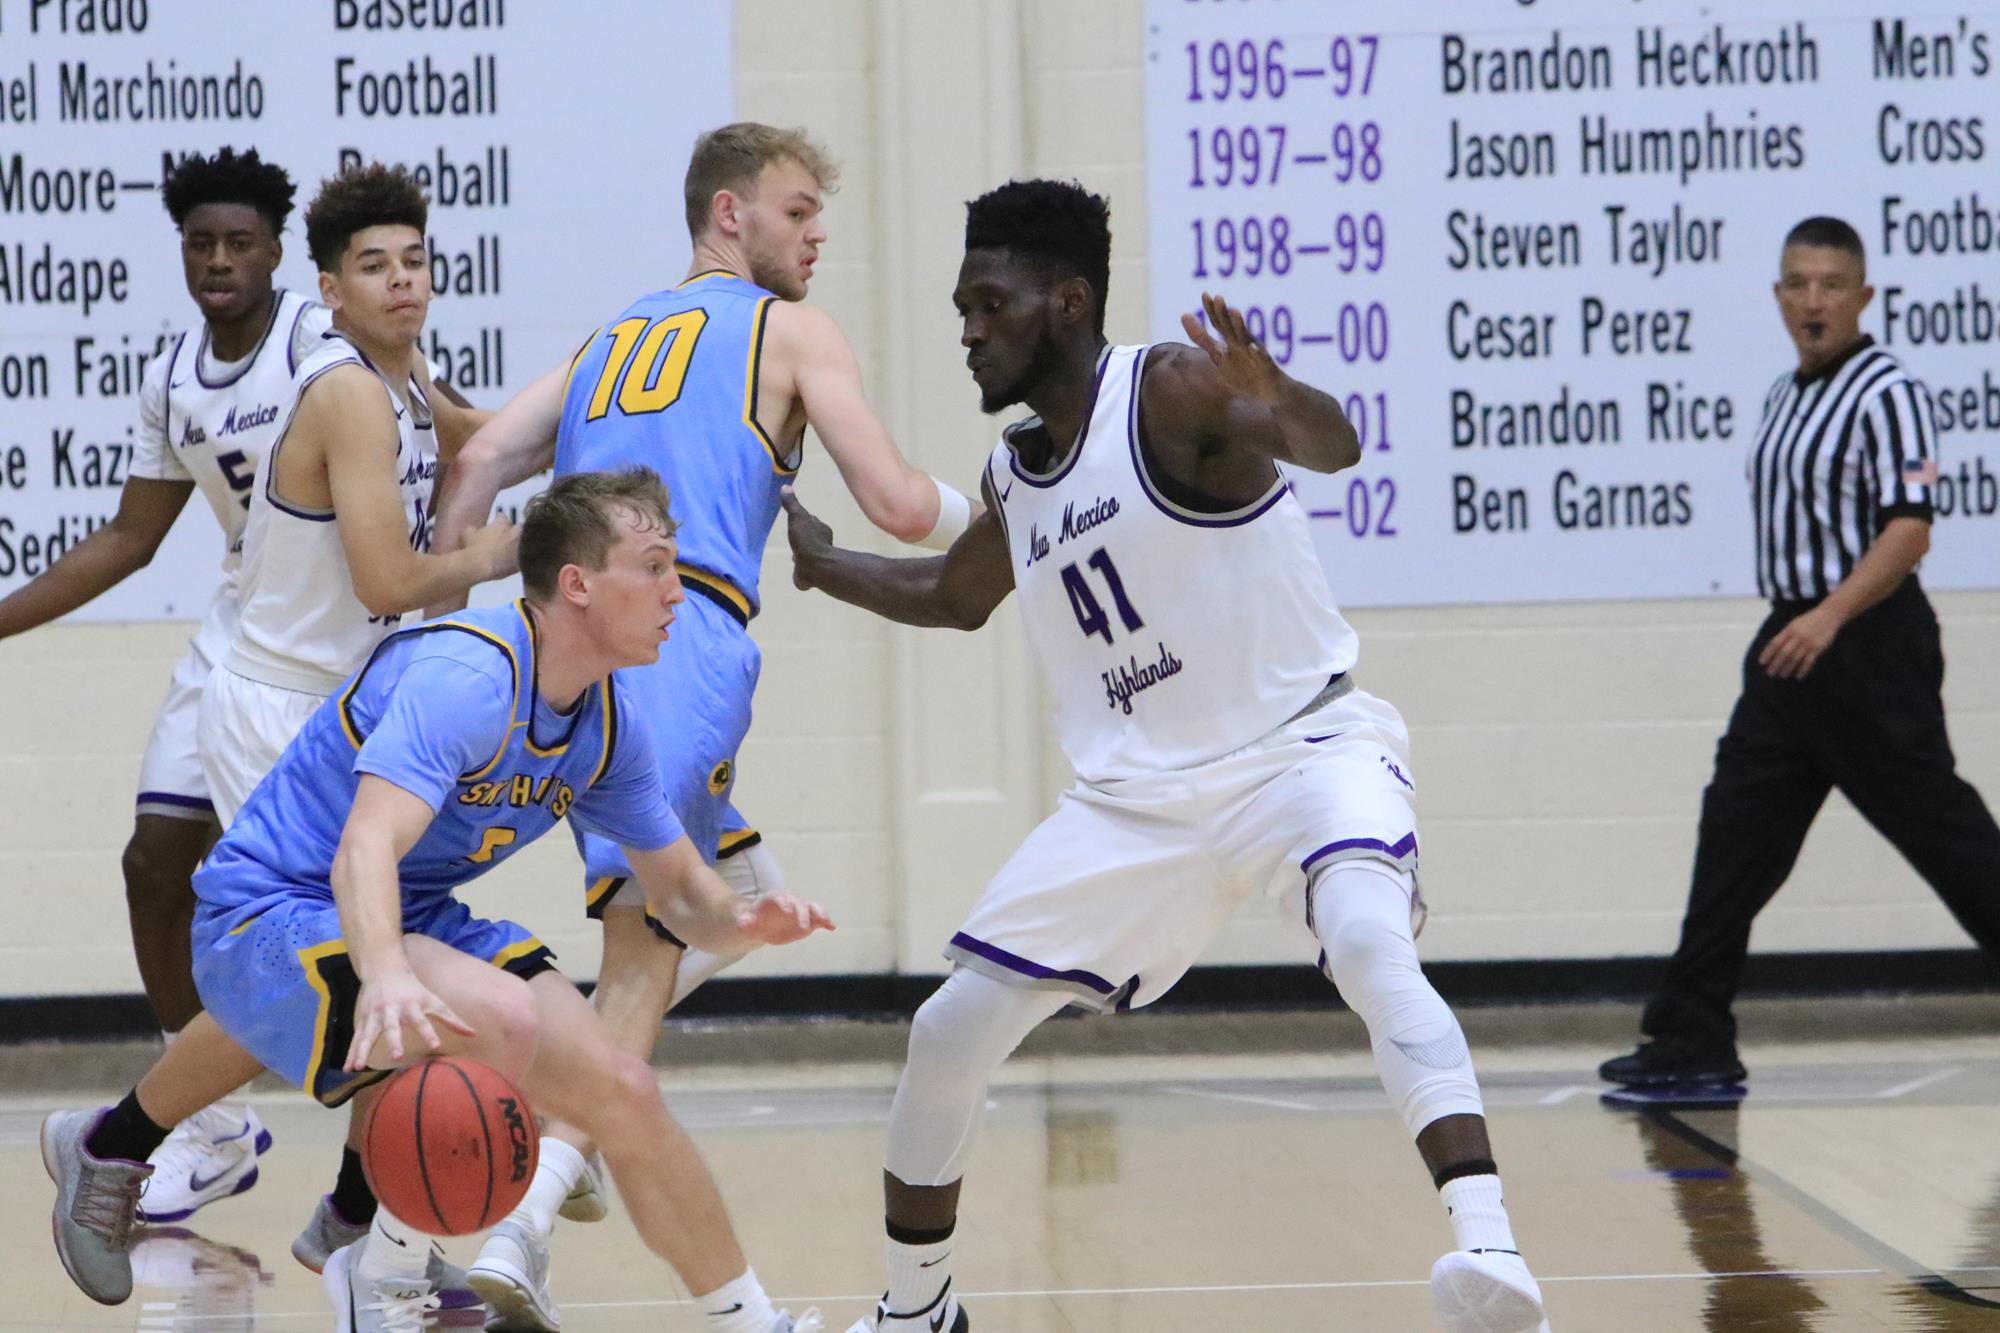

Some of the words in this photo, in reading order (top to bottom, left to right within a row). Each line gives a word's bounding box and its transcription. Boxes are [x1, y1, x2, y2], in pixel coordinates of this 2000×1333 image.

[1186, 35, 1379, 101] 1996-97
[1442, 29, 1612, 94] Brandon
[1636, 20, 1819, 88] Heckroth
[1873, 17, 1990, 79] Men's
[0, 60, 36, 122] el
[60, 58, 264, 122] Marchiondo
[335, 55, 496, 117] Football
[1188, 121, 1383, 188] 1997-98
[1446, 118, 1556, 181] Jason
[1580, 110, 1806, 187] Humphries
[1879, 103, 1985, 165] Cross
[1191, 211, 1386, 278] 1998-99
[1447, 209, 1581, 271] Steven
[1604, 202, 1725, 278] Taylor
[1883, 193, 2000, 256] Footb
[1190, 302, 1389, 366] 99-00
[1448, 299, 1556, 361] Cesar
[1581, 295, 1692, 356] Perez
[1885, 281, 2000, 346] Footb
[585, 307, 710, 424] 10
[216, 403, 278, 437] Mexico
[1450, 384, 1621, 449] Brandon
[1647, 380, 1735, 442] Rice
[1058, 496, 1120, 544] Mexico
[1453, 473, 1529, 534] Ben
[1553, 469, 1693, 530] Garnas
[1060, 545, 1146, 647] 41
[497, 1096, 529, 1183] NCAA
